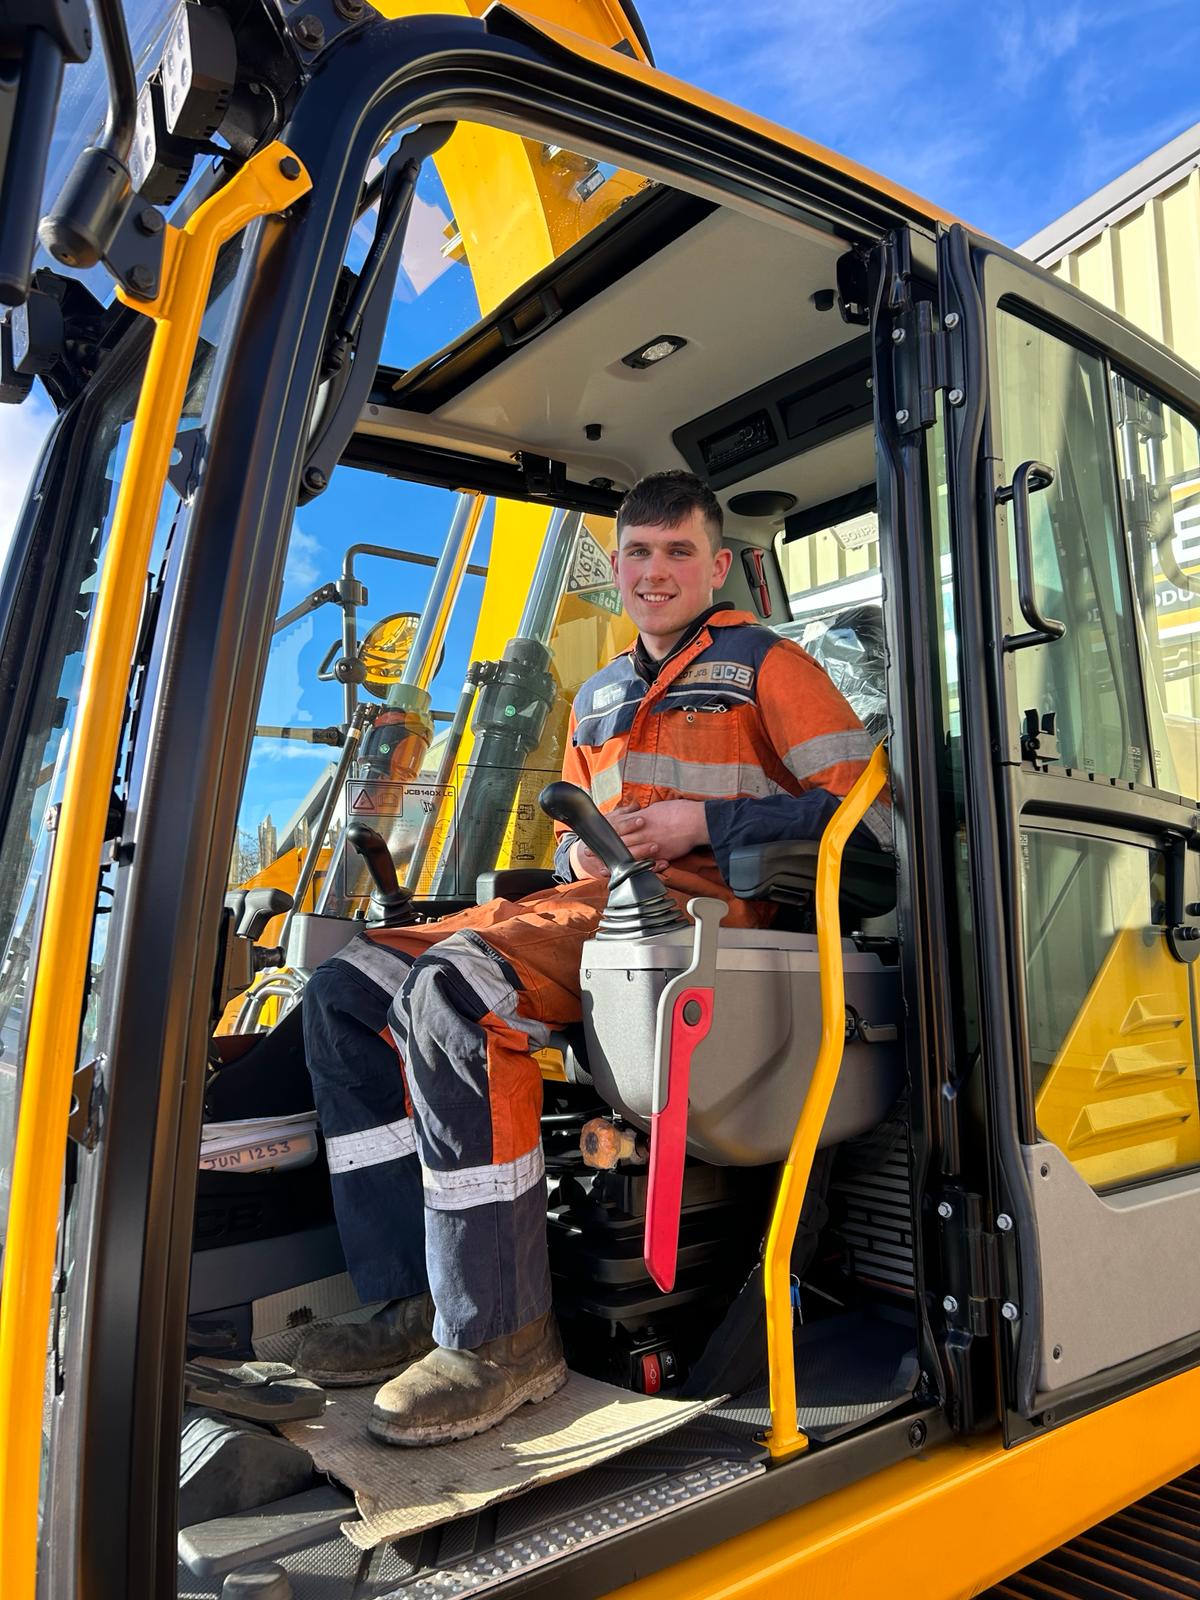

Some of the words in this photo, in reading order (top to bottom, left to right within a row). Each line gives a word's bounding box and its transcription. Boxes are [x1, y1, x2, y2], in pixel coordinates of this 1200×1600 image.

[712, 663, 752, 685] JCB
[204, 1153, 241, 1170] JUN
[248, 1140, 292, 1160] 1253
